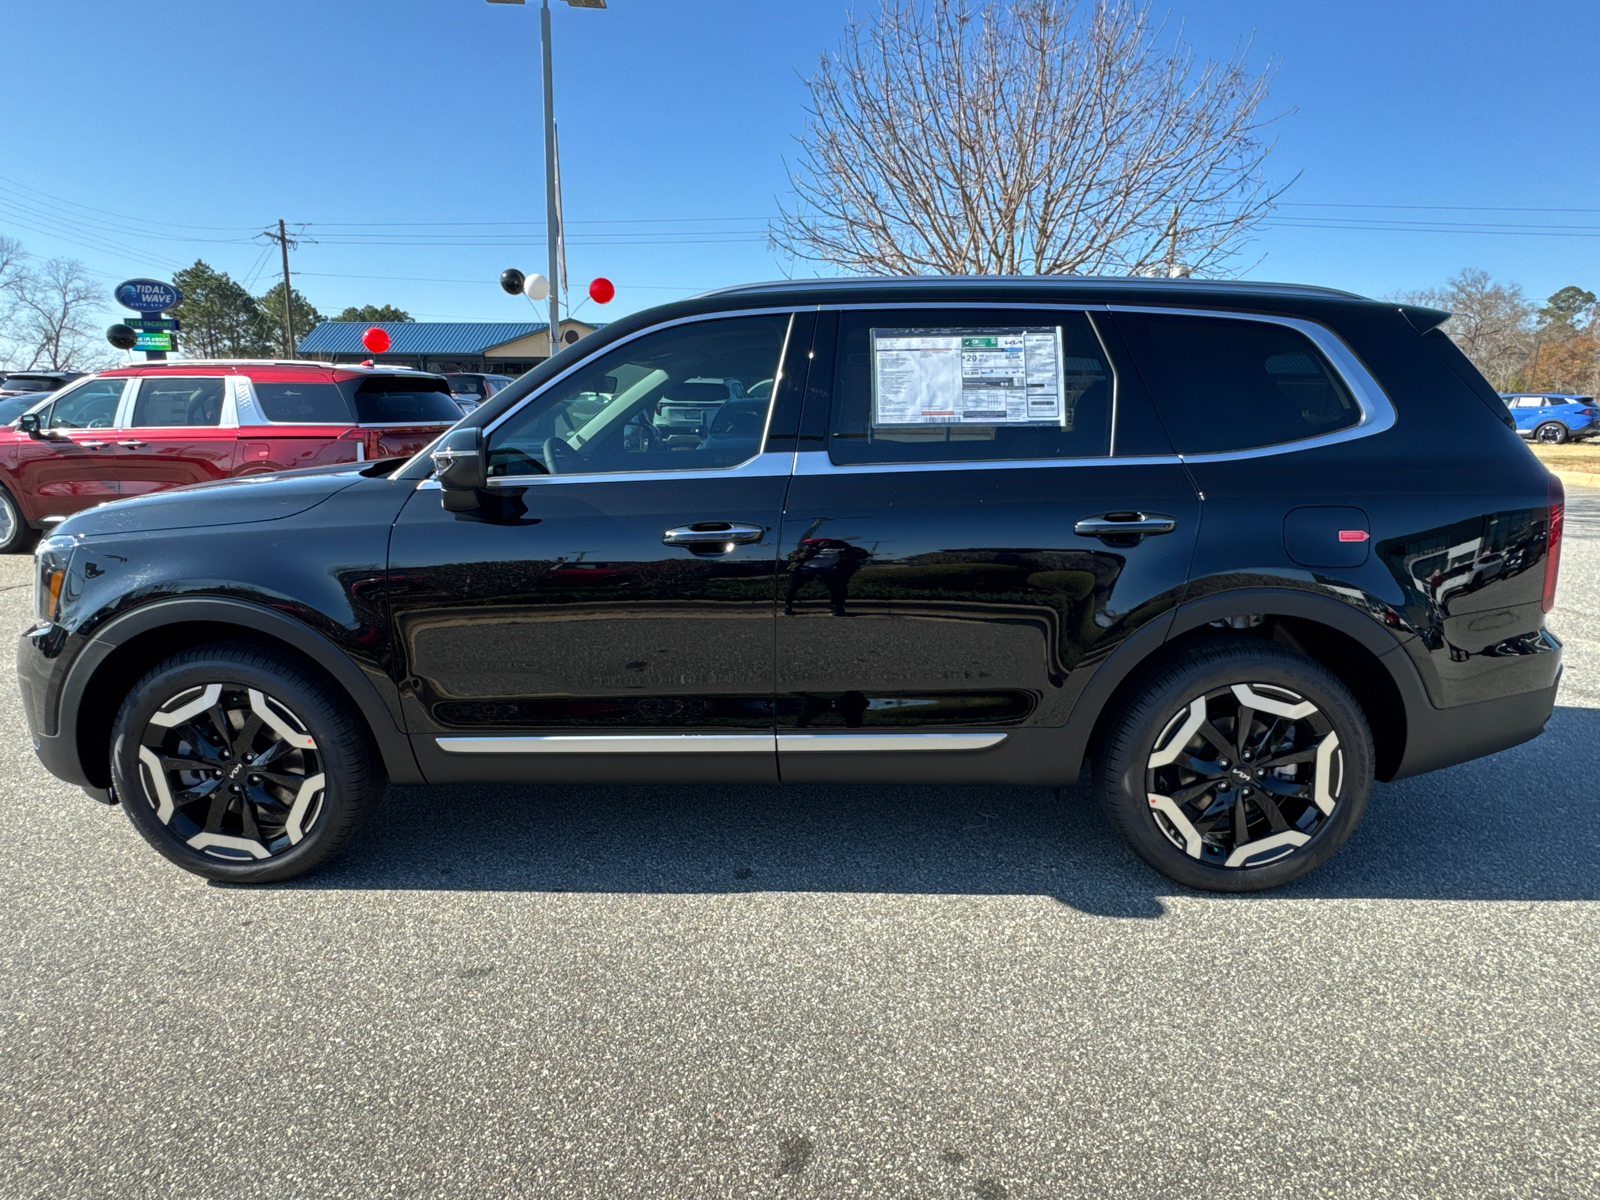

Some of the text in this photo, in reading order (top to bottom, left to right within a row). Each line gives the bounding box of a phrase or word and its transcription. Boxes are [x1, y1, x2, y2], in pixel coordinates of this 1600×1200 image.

[136, 285, 165, 294] TIDAL
[141, 294, 171, 303] WAVE
[966, 354, 977, 362] 20
